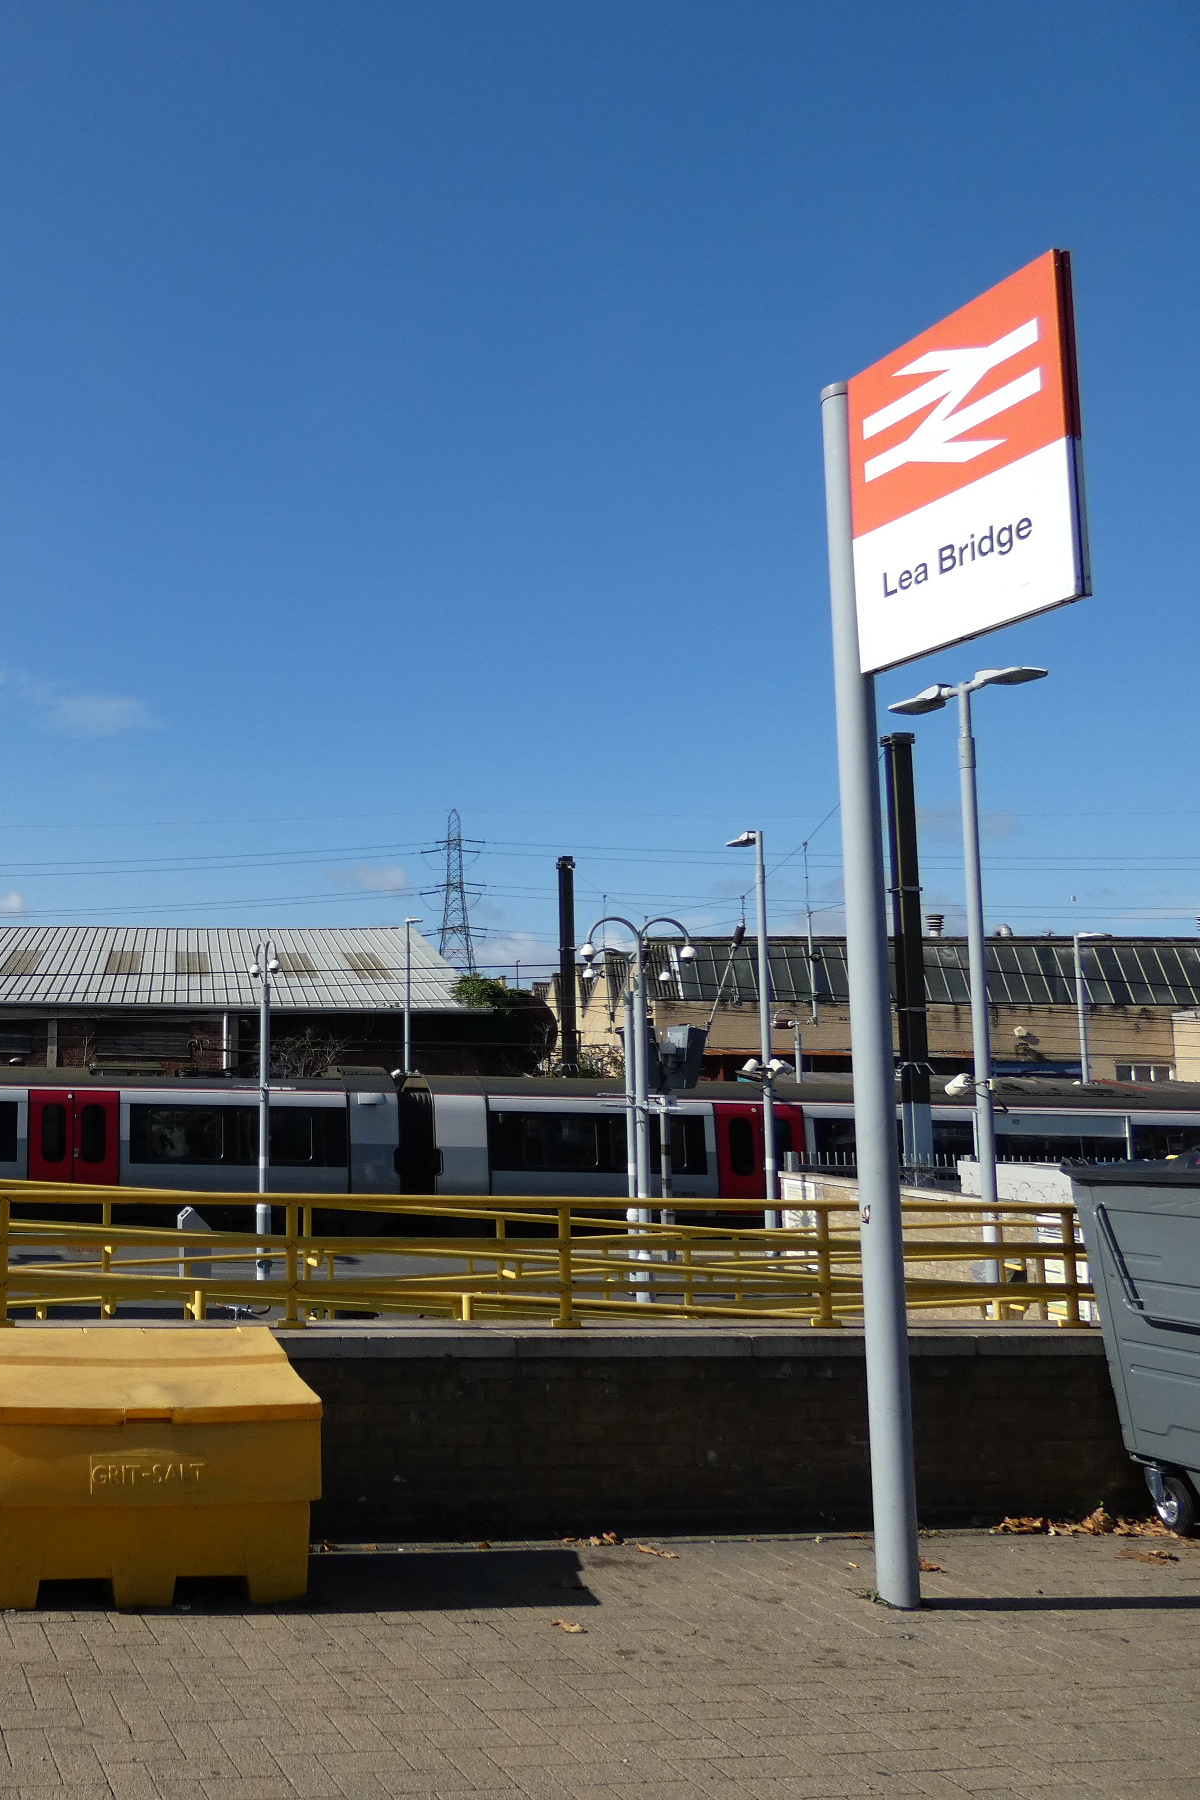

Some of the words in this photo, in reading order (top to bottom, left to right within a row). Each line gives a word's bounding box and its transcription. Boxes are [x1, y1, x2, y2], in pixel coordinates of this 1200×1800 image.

[882, 562, 929, 598] Lea
[938, 517, 1033, 575] Bridge
[91, 1463, 205, 1485] GRIT-SALT
